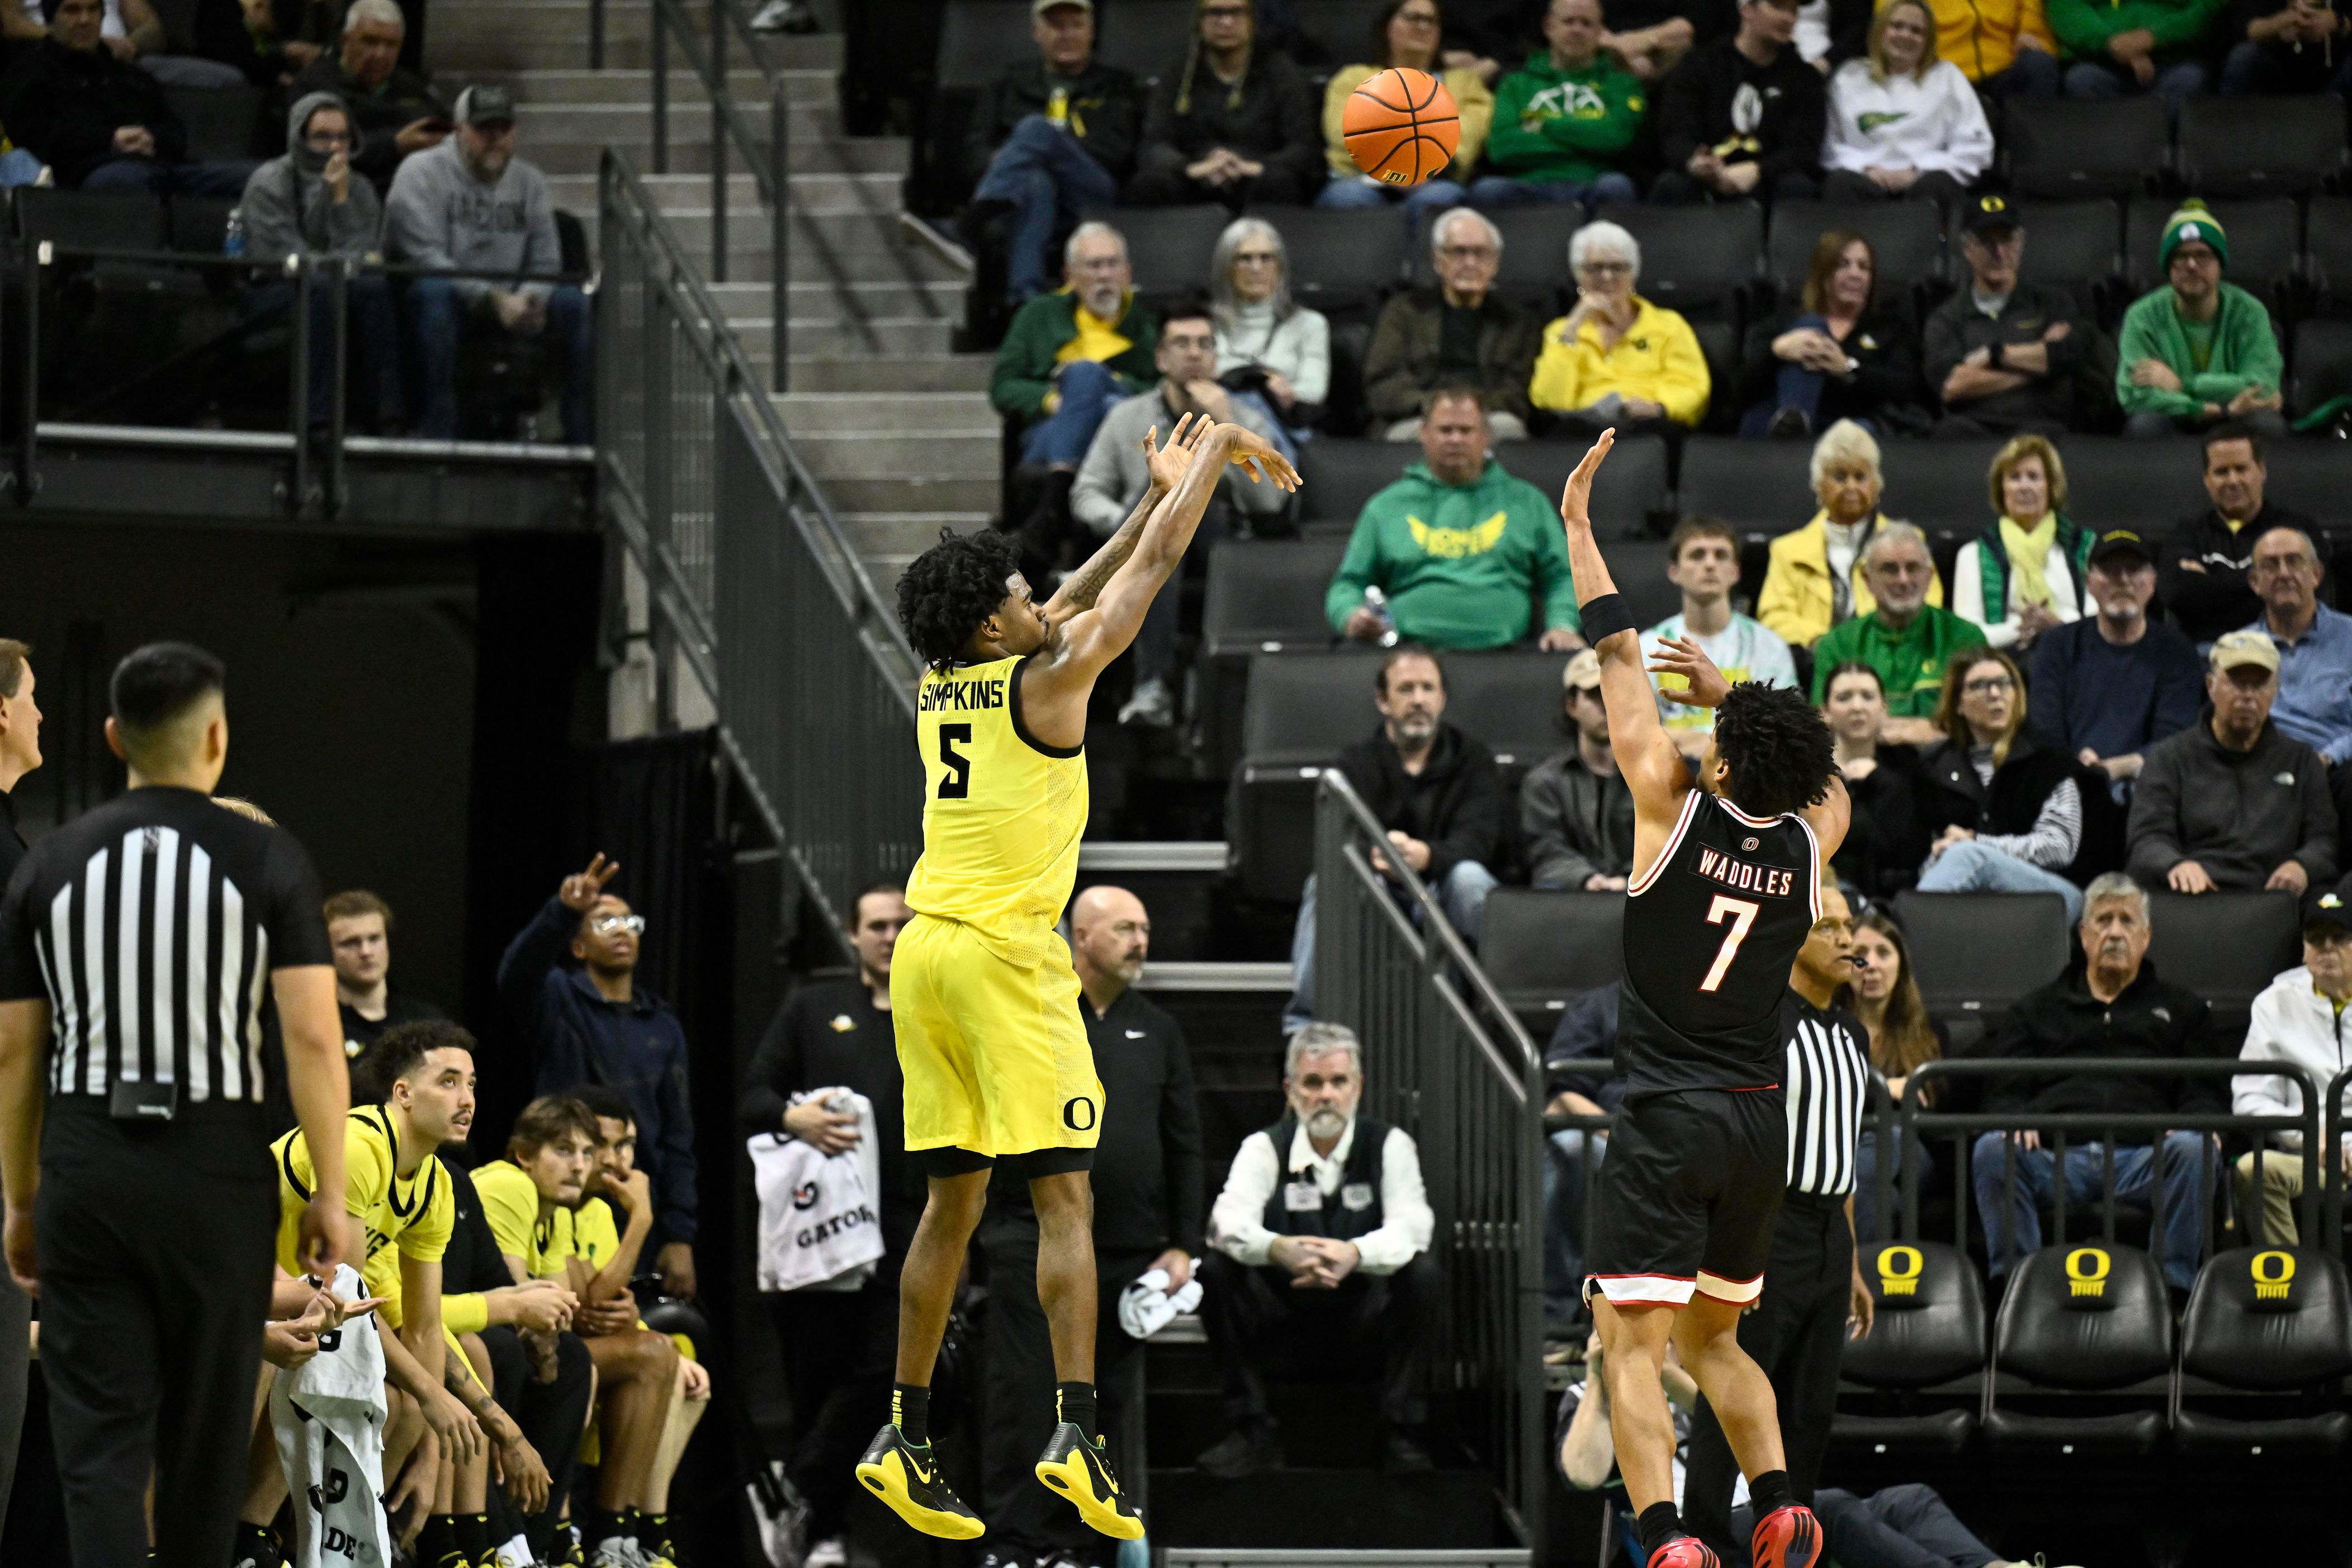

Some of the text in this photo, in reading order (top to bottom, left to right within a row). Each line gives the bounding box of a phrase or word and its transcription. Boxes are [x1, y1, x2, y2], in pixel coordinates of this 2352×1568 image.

[920, 680, 1004, 711] SIMPKINS
[938, 723, 972, 799] 5
[1698, 847, 1792, 896] WADDLES
[1698, 892, 1761, 993] 7
[1063, 1097, 1095, 1130] O
[1877, 1246, 1923, 1278] O
[2066, 1248, 2110, 1280] O
[2251, 1251, 2296, 1283] O
